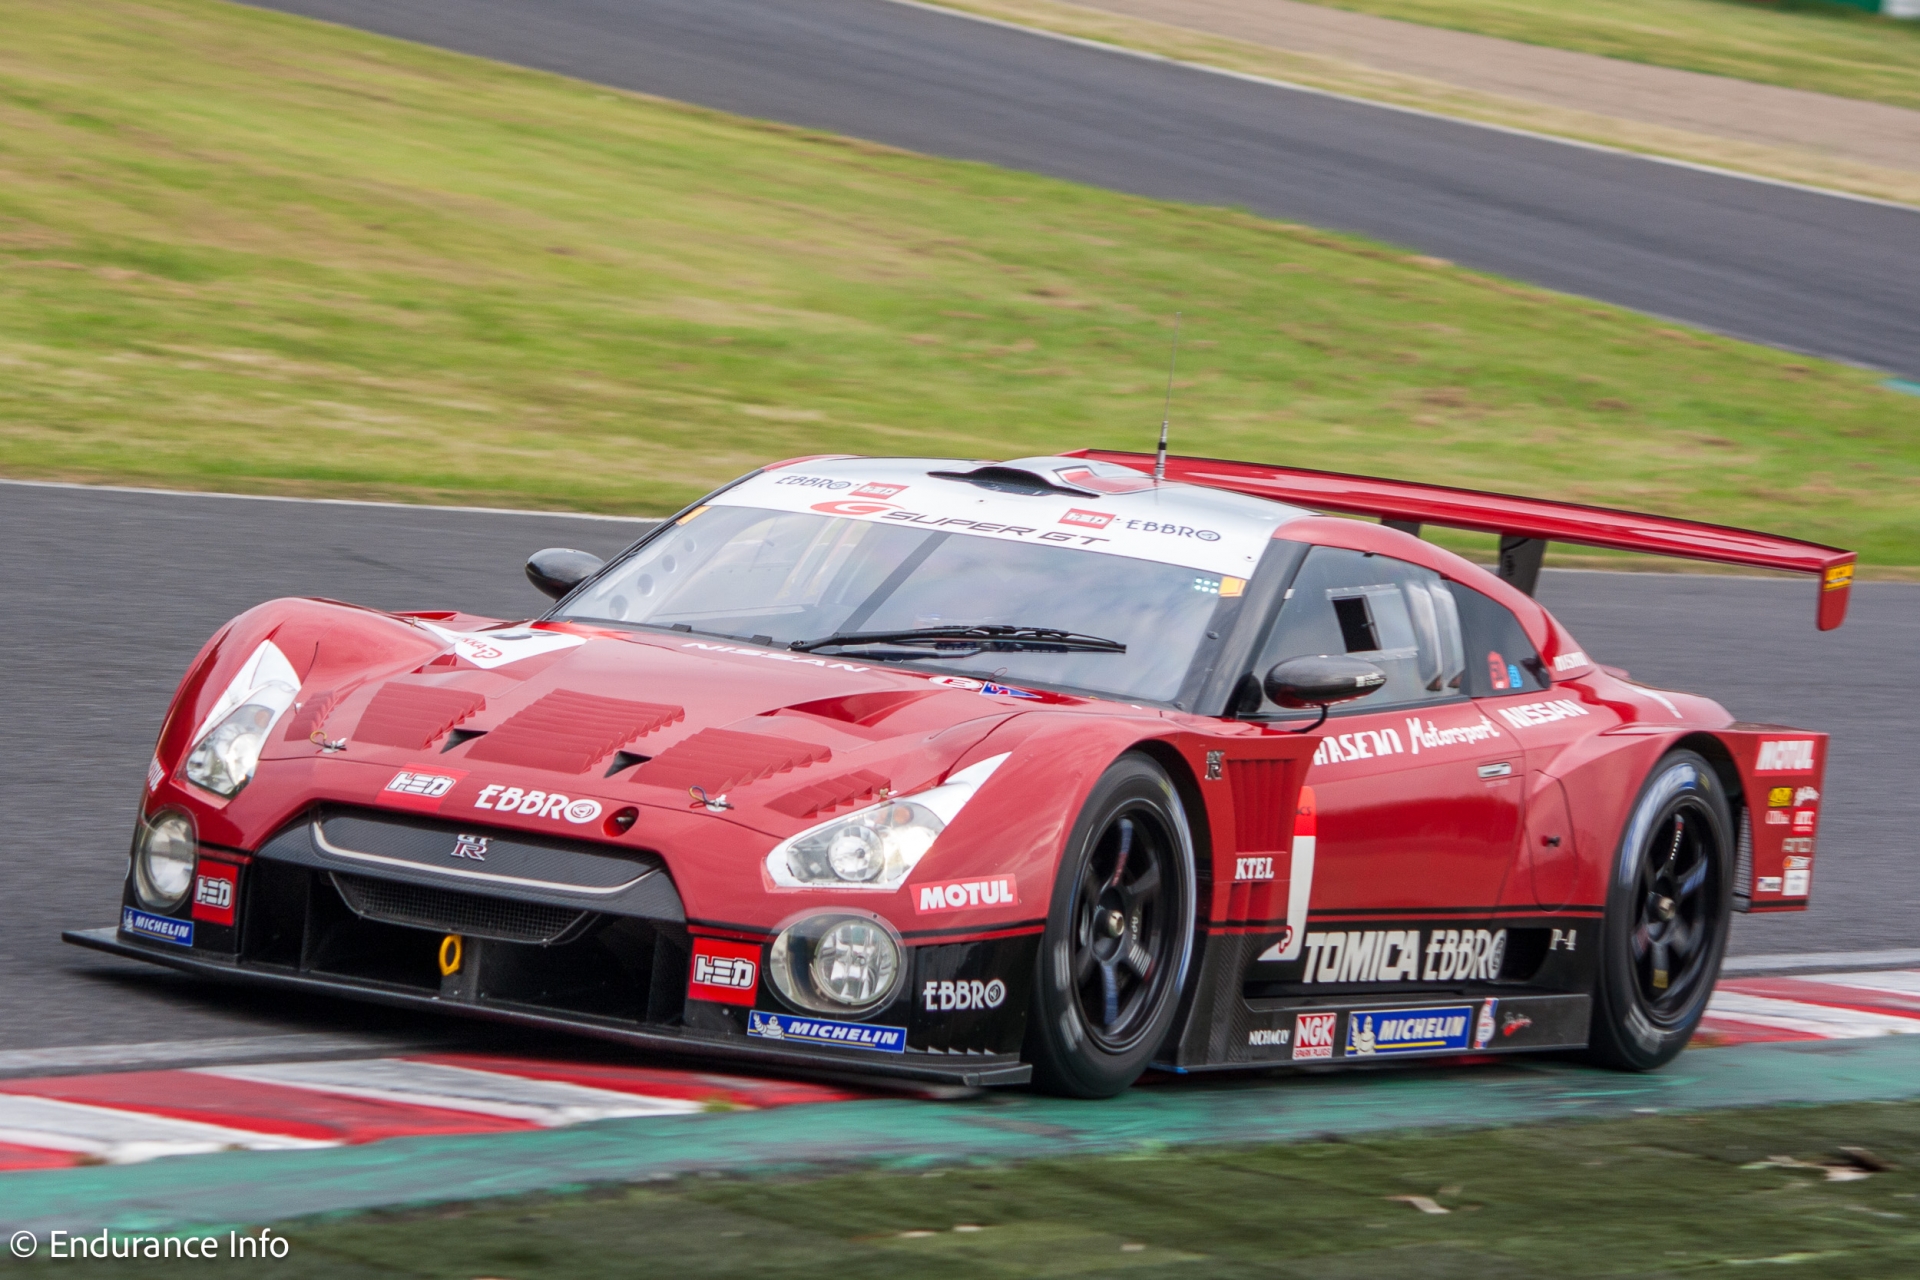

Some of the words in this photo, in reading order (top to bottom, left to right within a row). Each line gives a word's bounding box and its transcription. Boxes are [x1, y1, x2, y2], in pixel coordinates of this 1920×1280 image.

[775, 475, 851, 490] EBBRO
[881, 511, 1037, 537] SUPER
[1036, 531, 1111, 546] GT
[1125, 519, 1221, 542] EBBRO
[682, 642, 870, 672] NISSAN
[1497, 699, 1589, 729] NISSAN
[1405, 715, 1500, 754] Motorsport
[386, 771, 456, 797] トミカ
[474, 784, 602, 824] EBBRO
[451, 841, 488, 861] R
[1235, 857, 1274, 880] KTEL
[195, 875, 233, 909] トミカ
[920, 879, 1014, 910] MOTUL
[135, 917, 189, 938] MICHELIN
[1302, 930, 1420, 983] TOMICA
[1422, 928, 1507, 980] EBBRO
[693, 954, 756, 989] トミカ
[923, 979, 1006, 1011] EBBRO
[788, 1021, 900, 1045] MICHELIN
[1294, 1015, 1334, 1047] NGK
[1378, 1016, 1467, 1041] MICHELIN
